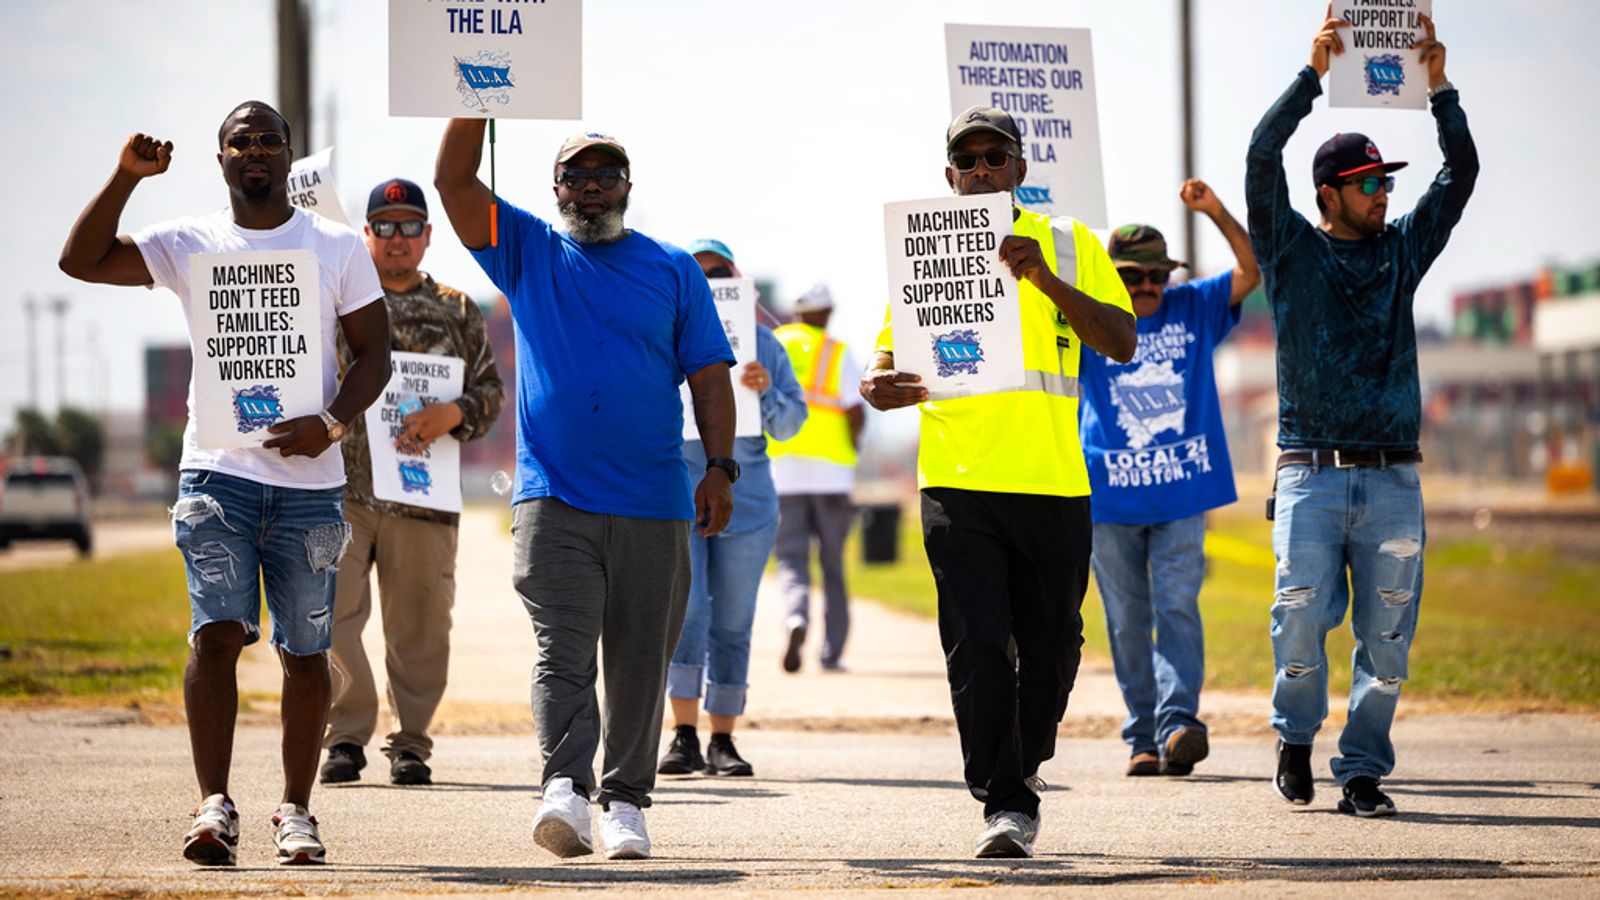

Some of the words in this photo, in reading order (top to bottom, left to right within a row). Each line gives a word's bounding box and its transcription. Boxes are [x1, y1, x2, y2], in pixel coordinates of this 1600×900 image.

[446, 8, 484, 33] THE
[491, 9, 522, 34] ILA
[1343, 9, 1404, 28] SUPPORT
[1353, 30, 1415, 49] WORKERS
[969, 41, 1069, 64] AUTOMATION
[958, 66, 1046, 88] THREATENS
[1051, 69, 1083, 90] OUR
[991, 92, 1054, 113] FUTURE:
[1032, 119, 1072, 138] WITH
[1031, 143, 1057, 162] ILA
[300, 170, 321, 188] ILA
[907, 208, 989, 233] MACHINES
[904, 234, 952, 257] DON'T
[957, 231, 996, 253] FEED
[212, 263, 295, 286] MACHINES
[913, 255, 990, 280] FAMILIES:
[209, 289, 256, 310] DON'T
[261, 287, 300, 307] FEED
[903, 280, 974, 304] SUPPORT
[979, 278, 1005, 299] ILA
[217, 311, 294, 333] FAMILIES:
[917, 302, 994, 327] WORKERS
[207, 336, 277, 358] SUPPORT
[282, 334, 307, 355] ILA
[219, 359, 296, 380] WORKERS
[400, 360, 450, 379] WORKERS
[1128, 388, 1186, 412] I.L.A.
[1104, 447, 1179, 470] LOCAL
[1185, 438, 1207, 458] 24
[1108, 463, 1192, 487] HOUSTON,
